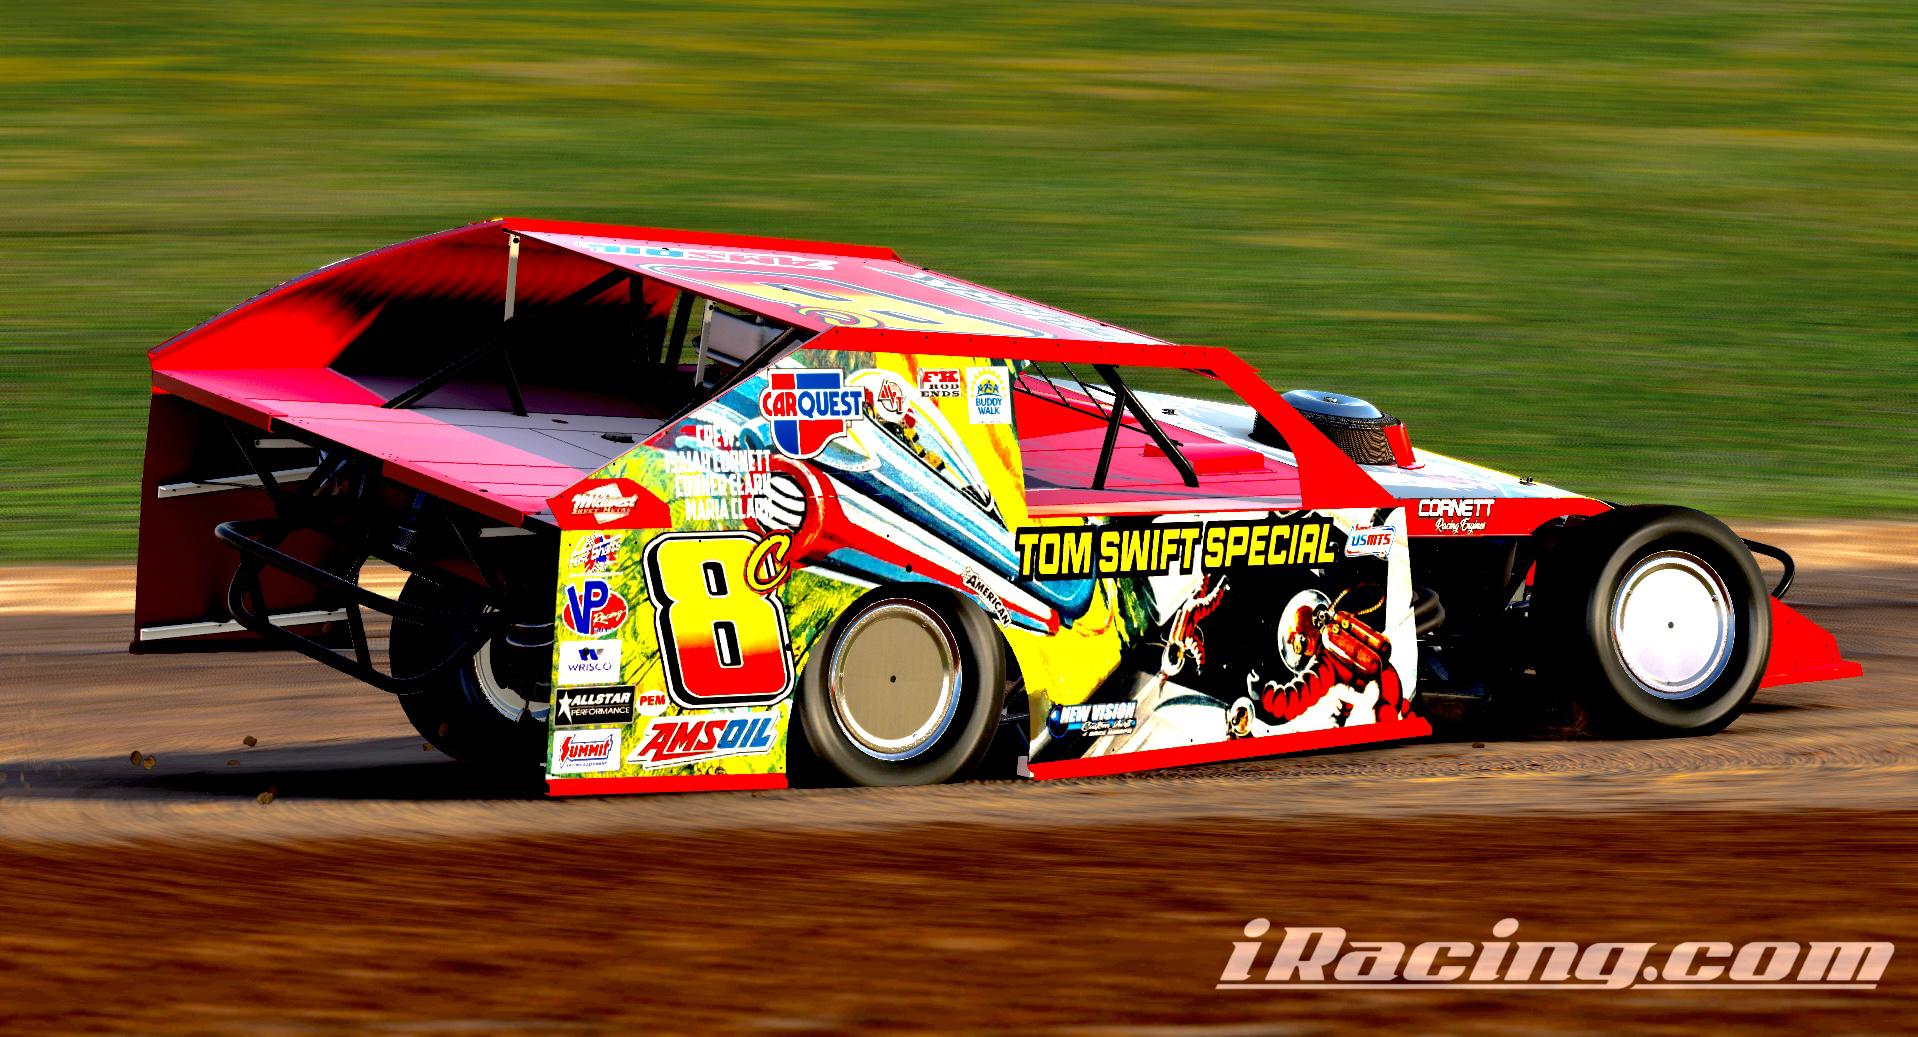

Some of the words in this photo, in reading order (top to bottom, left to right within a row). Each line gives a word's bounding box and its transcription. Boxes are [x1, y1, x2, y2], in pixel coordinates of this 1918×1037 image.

[922, 370, 959, 383] FK
[920, 390, 961, 398] ENDS
[975, 397, 1002, 407] BUDDY
[762, 390, 863, 419] CARQUEST
[978, 406, 1001, 415] WALK
[713, 449, 771, 472] CORNETT
[729, 473, 771, 495] CLARK
[685, 498, 729, 520] MARIA
[1418, 498, 1495, 517] CORNETT
[1018, 532, 1093, 576] TOM
[1099, 528, 1201, 573] SWIFT
[1205, 523, 1335, 567] SPECIAL
[1351, 533, 1392, 547] USMTS
[567, 580, 609, 635] VP
[965, 574, 1011, 625] AMERICAN
[567, 662, 612, 672] WRISCO
[570, 692, 633, 706] ALLSTAR
[639, 694, 666, 706] PEM
[571, 706, 630, 716] PERFORMANCE
[1060, 705, 1092, 724] NEW
[1091, 702, 1136, 721] VISION
[638, 717, 773, 763] AMSOIL
